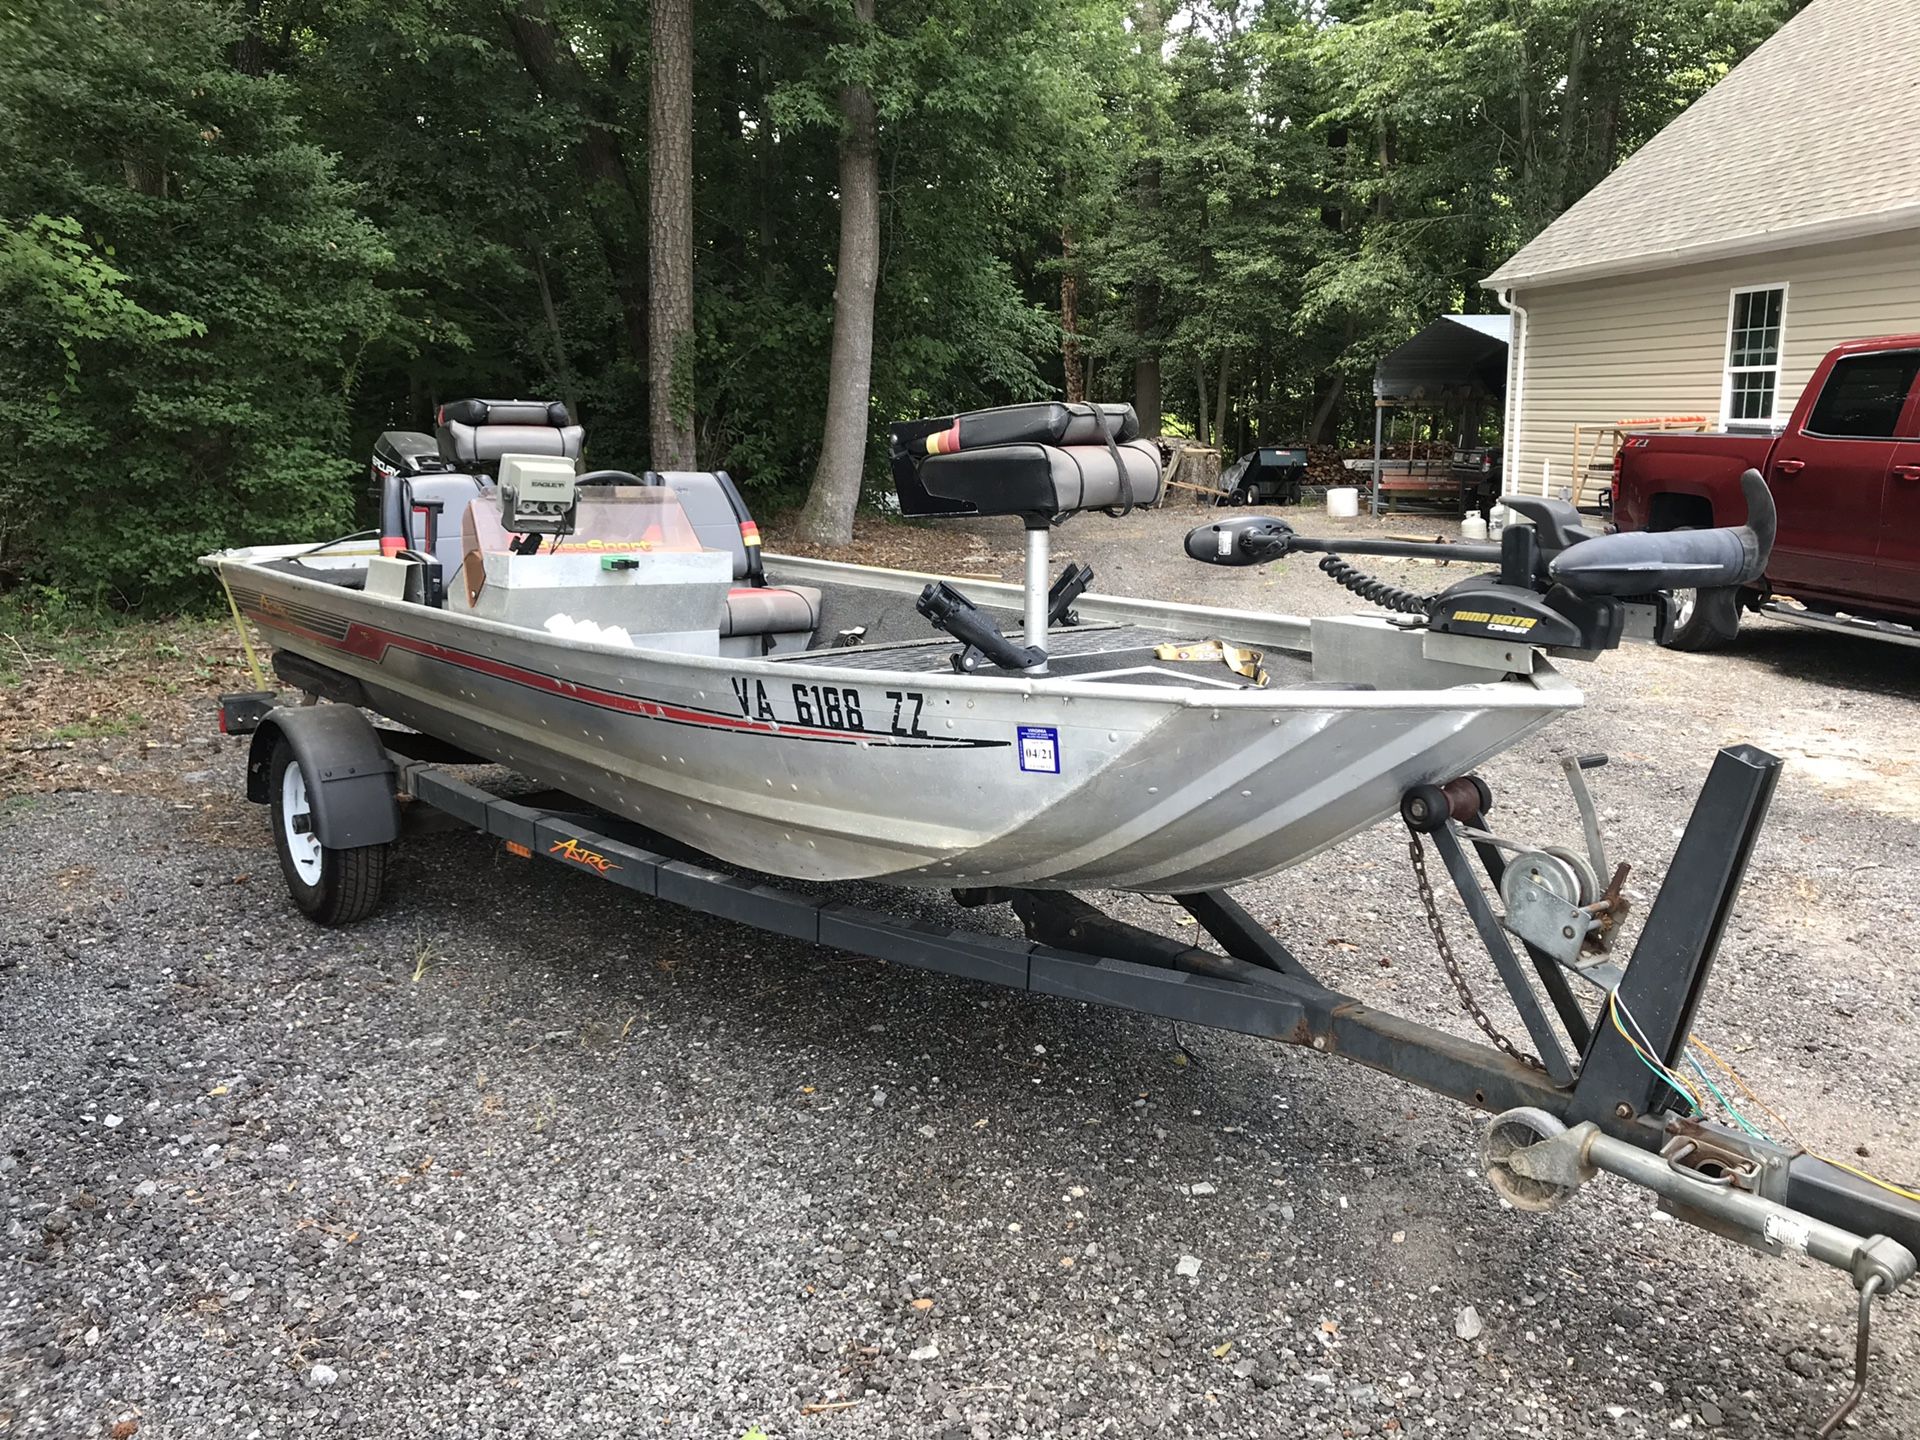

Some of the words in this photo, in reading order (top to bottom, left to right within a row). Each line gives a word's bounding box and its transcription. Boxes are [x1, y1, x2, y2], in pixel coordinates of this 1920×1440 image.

[1625, 438, 1649, 448] Z71
[1489, 613, 1538, 629] KOTA
[731, 677, 776, 720] VA
[792, 683, 865, 731] 6188
[886, 691, 928, 738] ZZ
